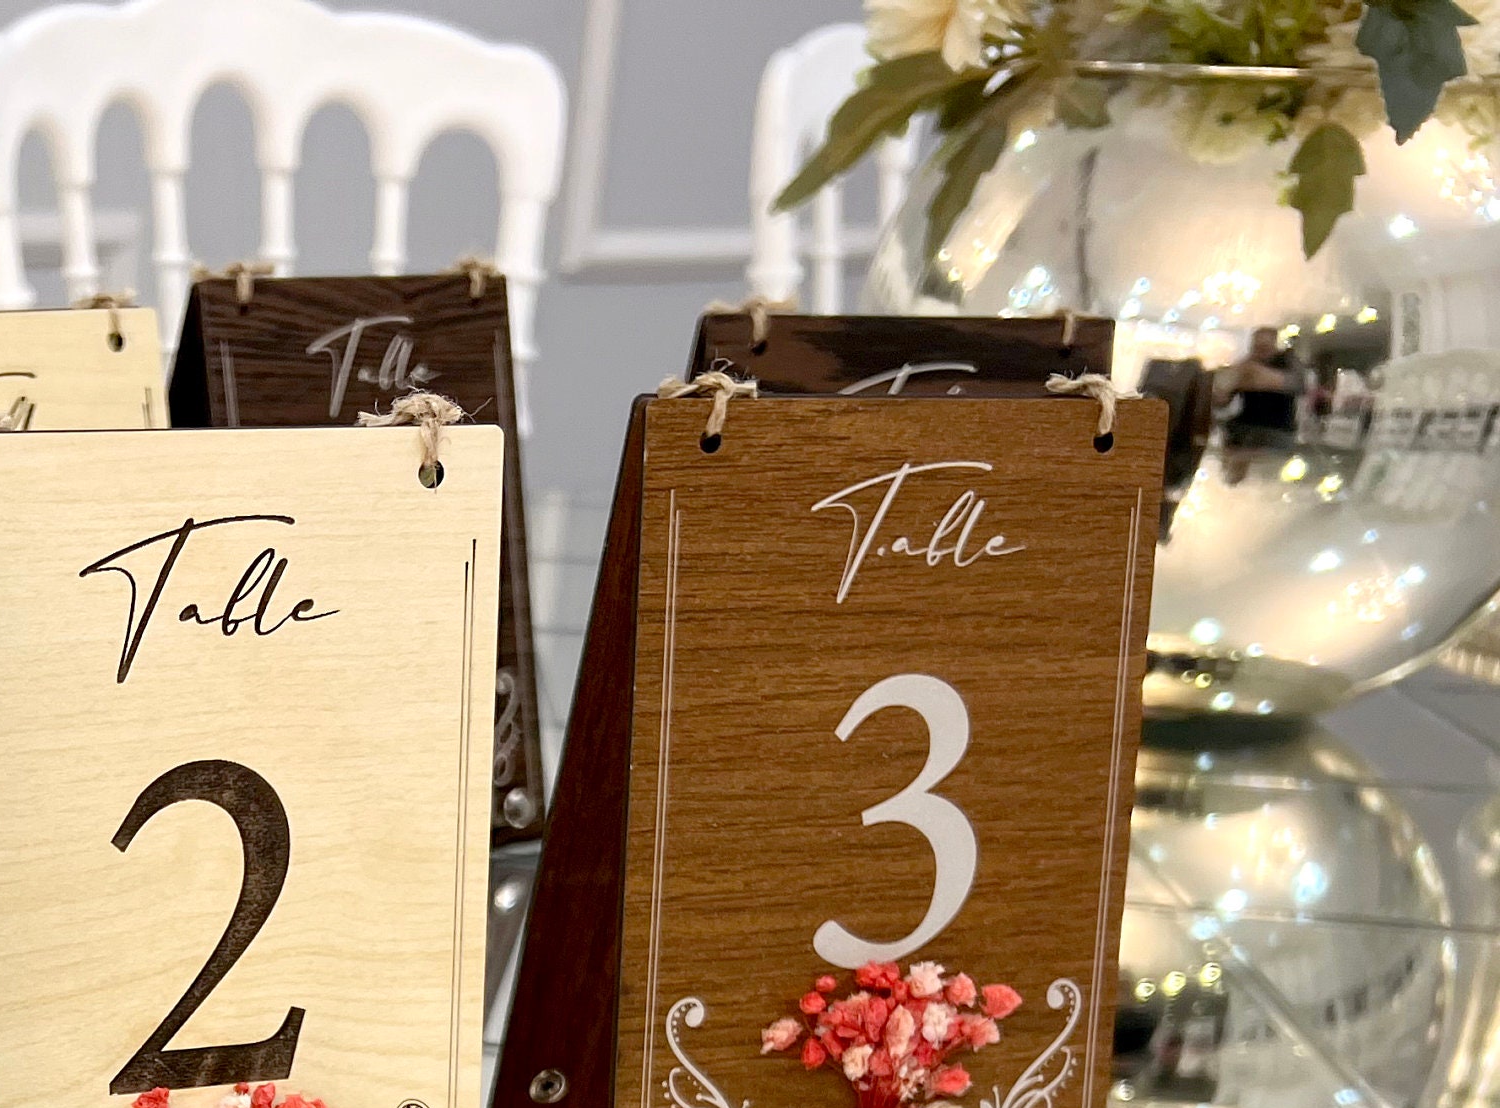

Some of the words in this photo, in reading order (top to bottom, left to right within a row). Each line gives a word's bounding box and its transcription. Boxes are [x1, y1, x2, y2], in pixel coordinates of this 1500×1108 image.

[78, 514, 341, 684] Table
[810, 461, 1026, 604] Table
[108, 759, 306, 1096] 2
[812, 673, 978, 970] 3
